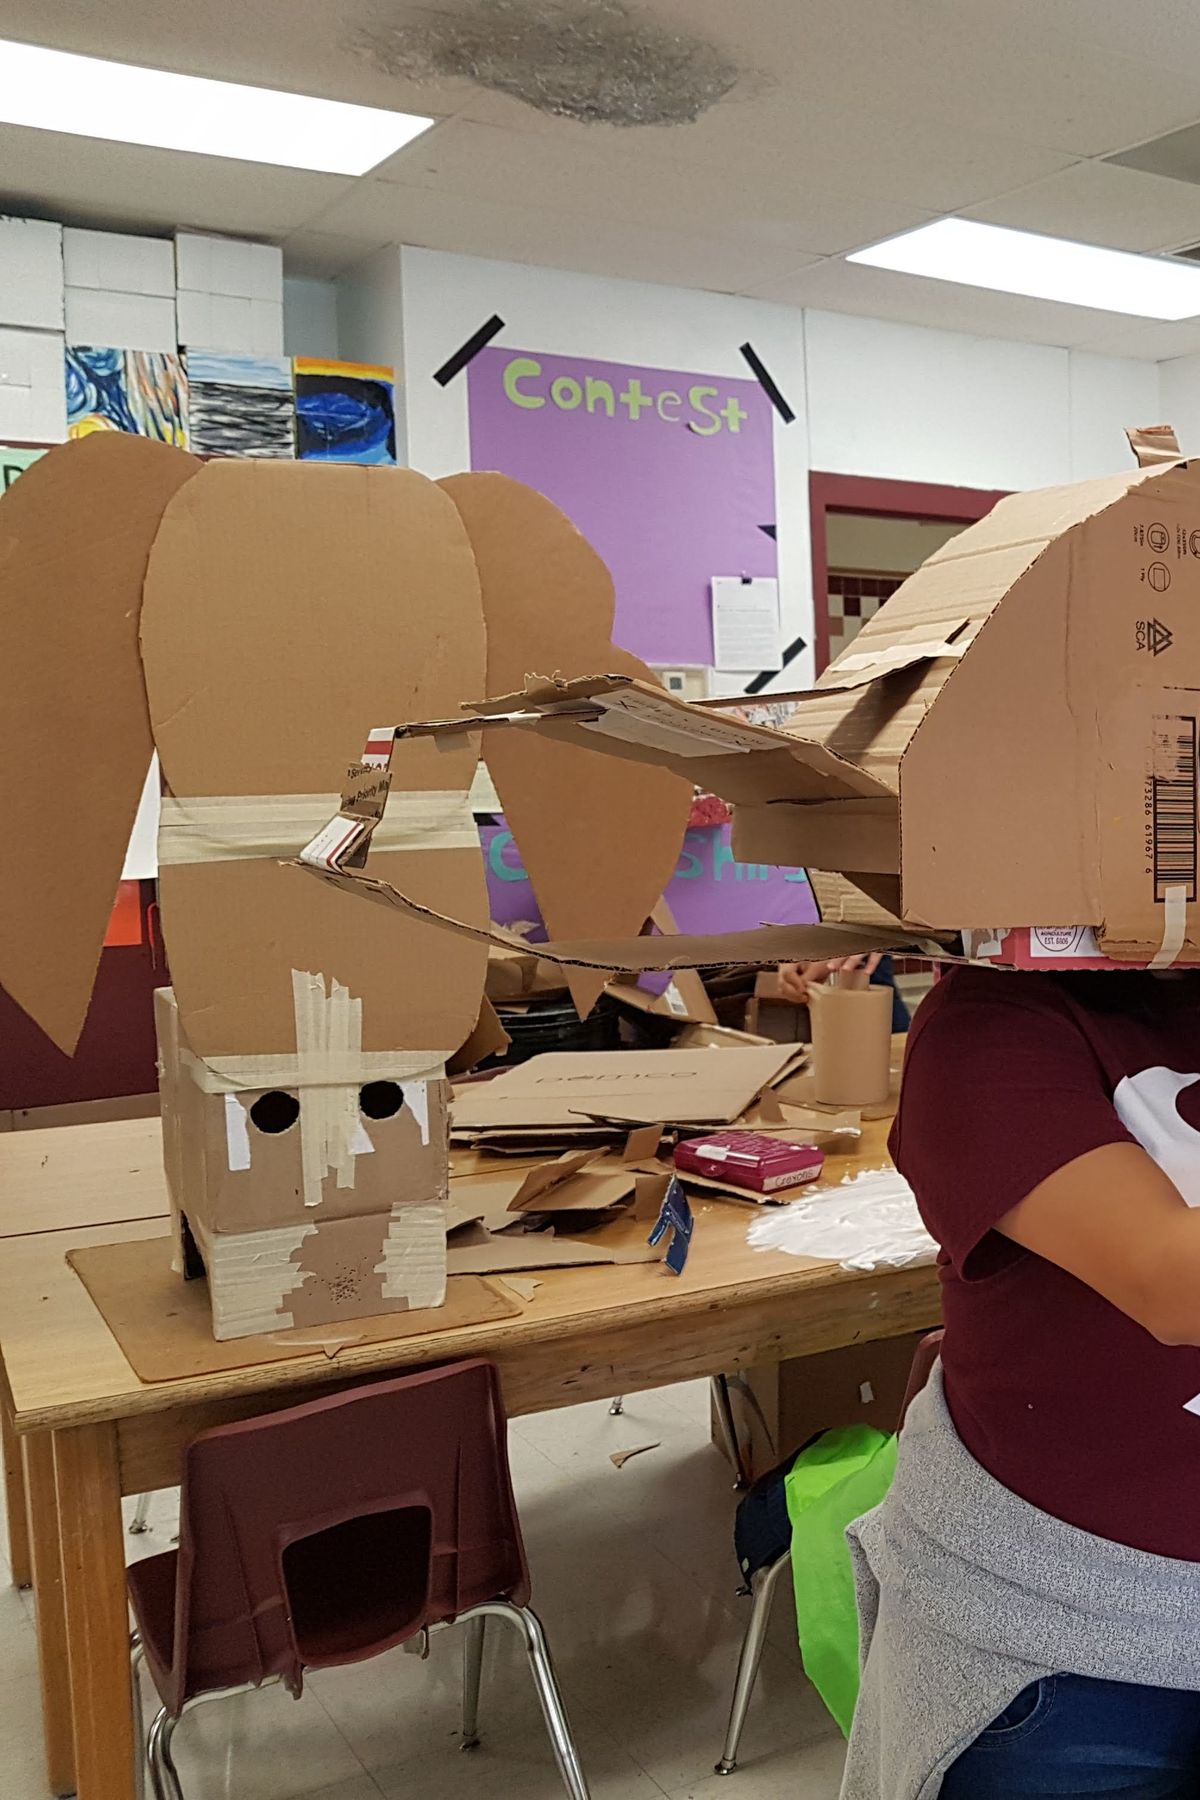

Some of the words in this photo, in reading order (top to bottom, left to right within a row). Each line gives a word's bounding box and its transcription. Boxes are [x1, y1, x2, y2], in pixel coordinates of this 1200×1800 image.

[1135, 620, 1146, 651] SCA
[1144, 781, 1153, 816] 73286
[1144, 824, 1153, 860] 61967
[1144, 867, 1153, 875] 6
